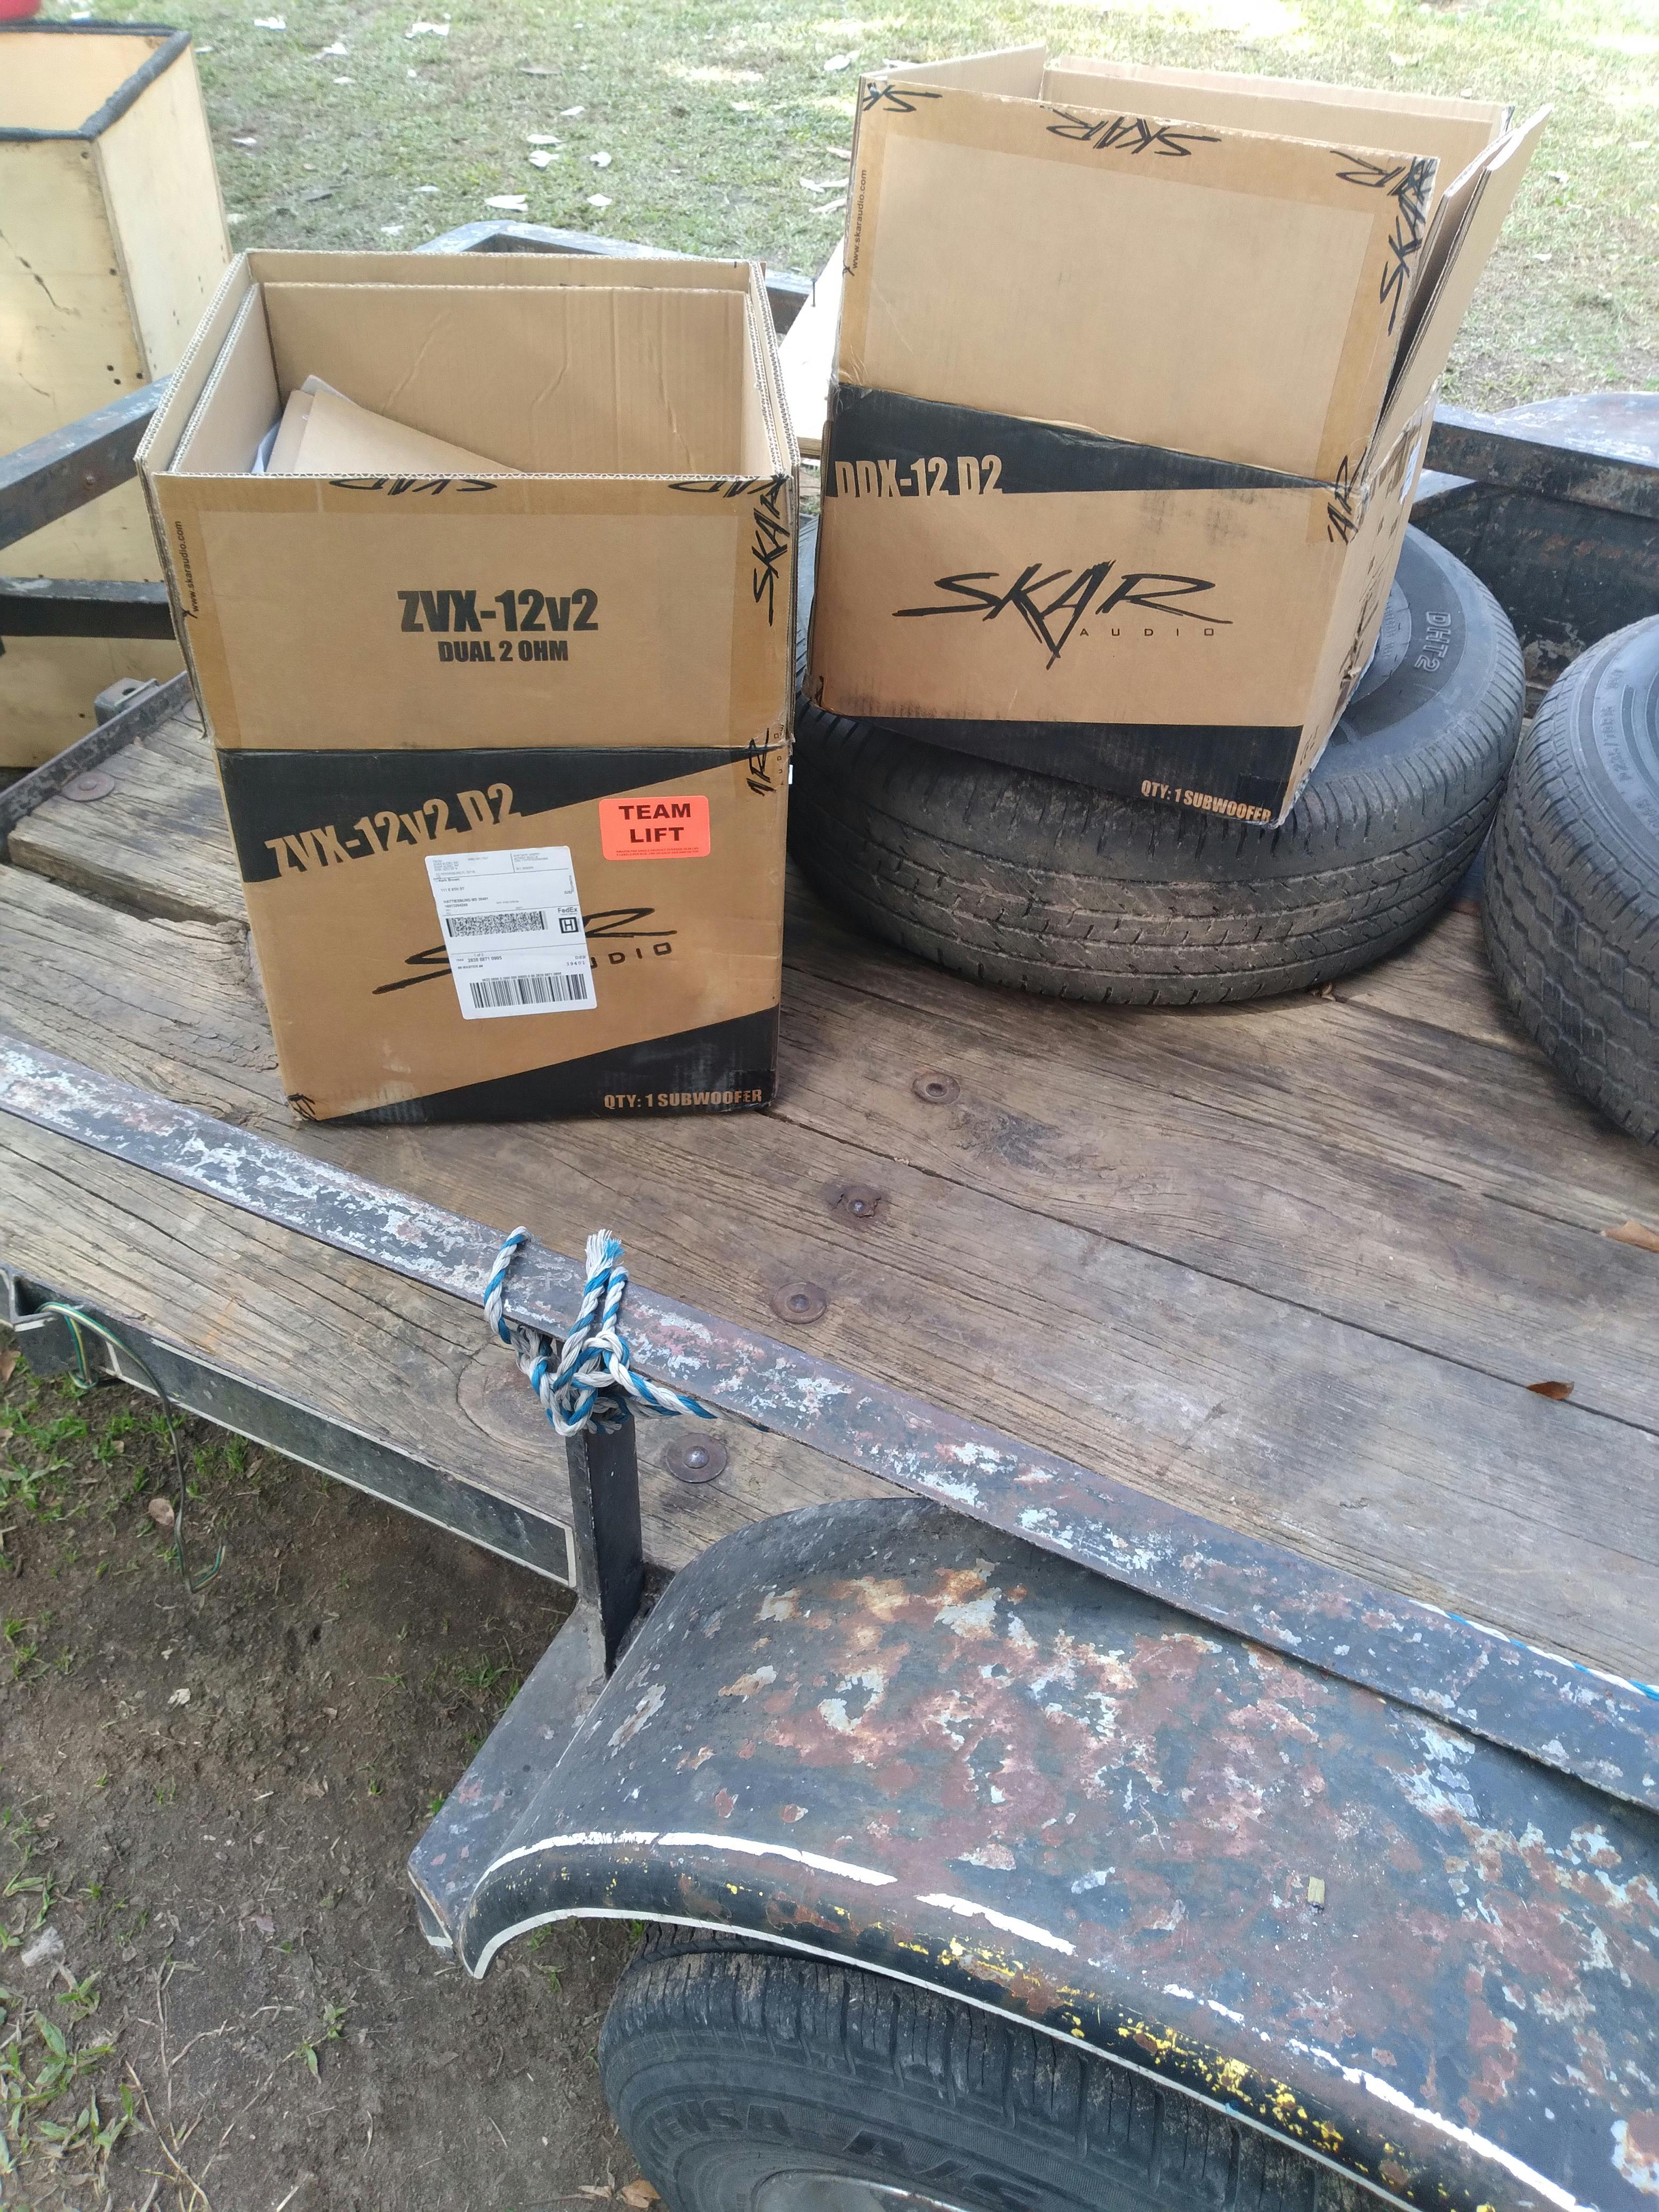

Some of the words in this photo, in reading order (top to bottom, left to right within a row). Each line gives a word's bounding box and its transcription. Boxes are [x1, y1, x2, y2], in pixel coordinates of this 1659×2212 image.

[852, 169, 868, 270] www.skaraudio.com
[834, 457, 949, 499] DDX-12
[957, 454, 1003, 496] D2
[174, 521, 199, 613] www.skaraudio.com
[397, 588, 599, 632] ZVX-12v2
[891, 559, 1234, 671] SKAR
[438, 641, 496, 663] DUAL
[498, 640, 513, 661] 2
[518, 640, 568, 661] OHM
[1079, 627, 1214, 638] AUDIO
[618, 803, 691, 820] TEAM
[1141, 780, 1171, 800] QTY:
[1175, 788, 1182, 802] 1
[1183, 790, 1272, 823] SUBWOOFER
[264, 798, 458, 877] ZVX-12v2
[456, 783, 523, 833] D2
[630, 827, 685, 843] LIFT
[604, 1094, 641, 1110] QTY:
[645, 1094, 653, 1108] 1
[657, 1089, 762, 1107] SUBWOOFER
